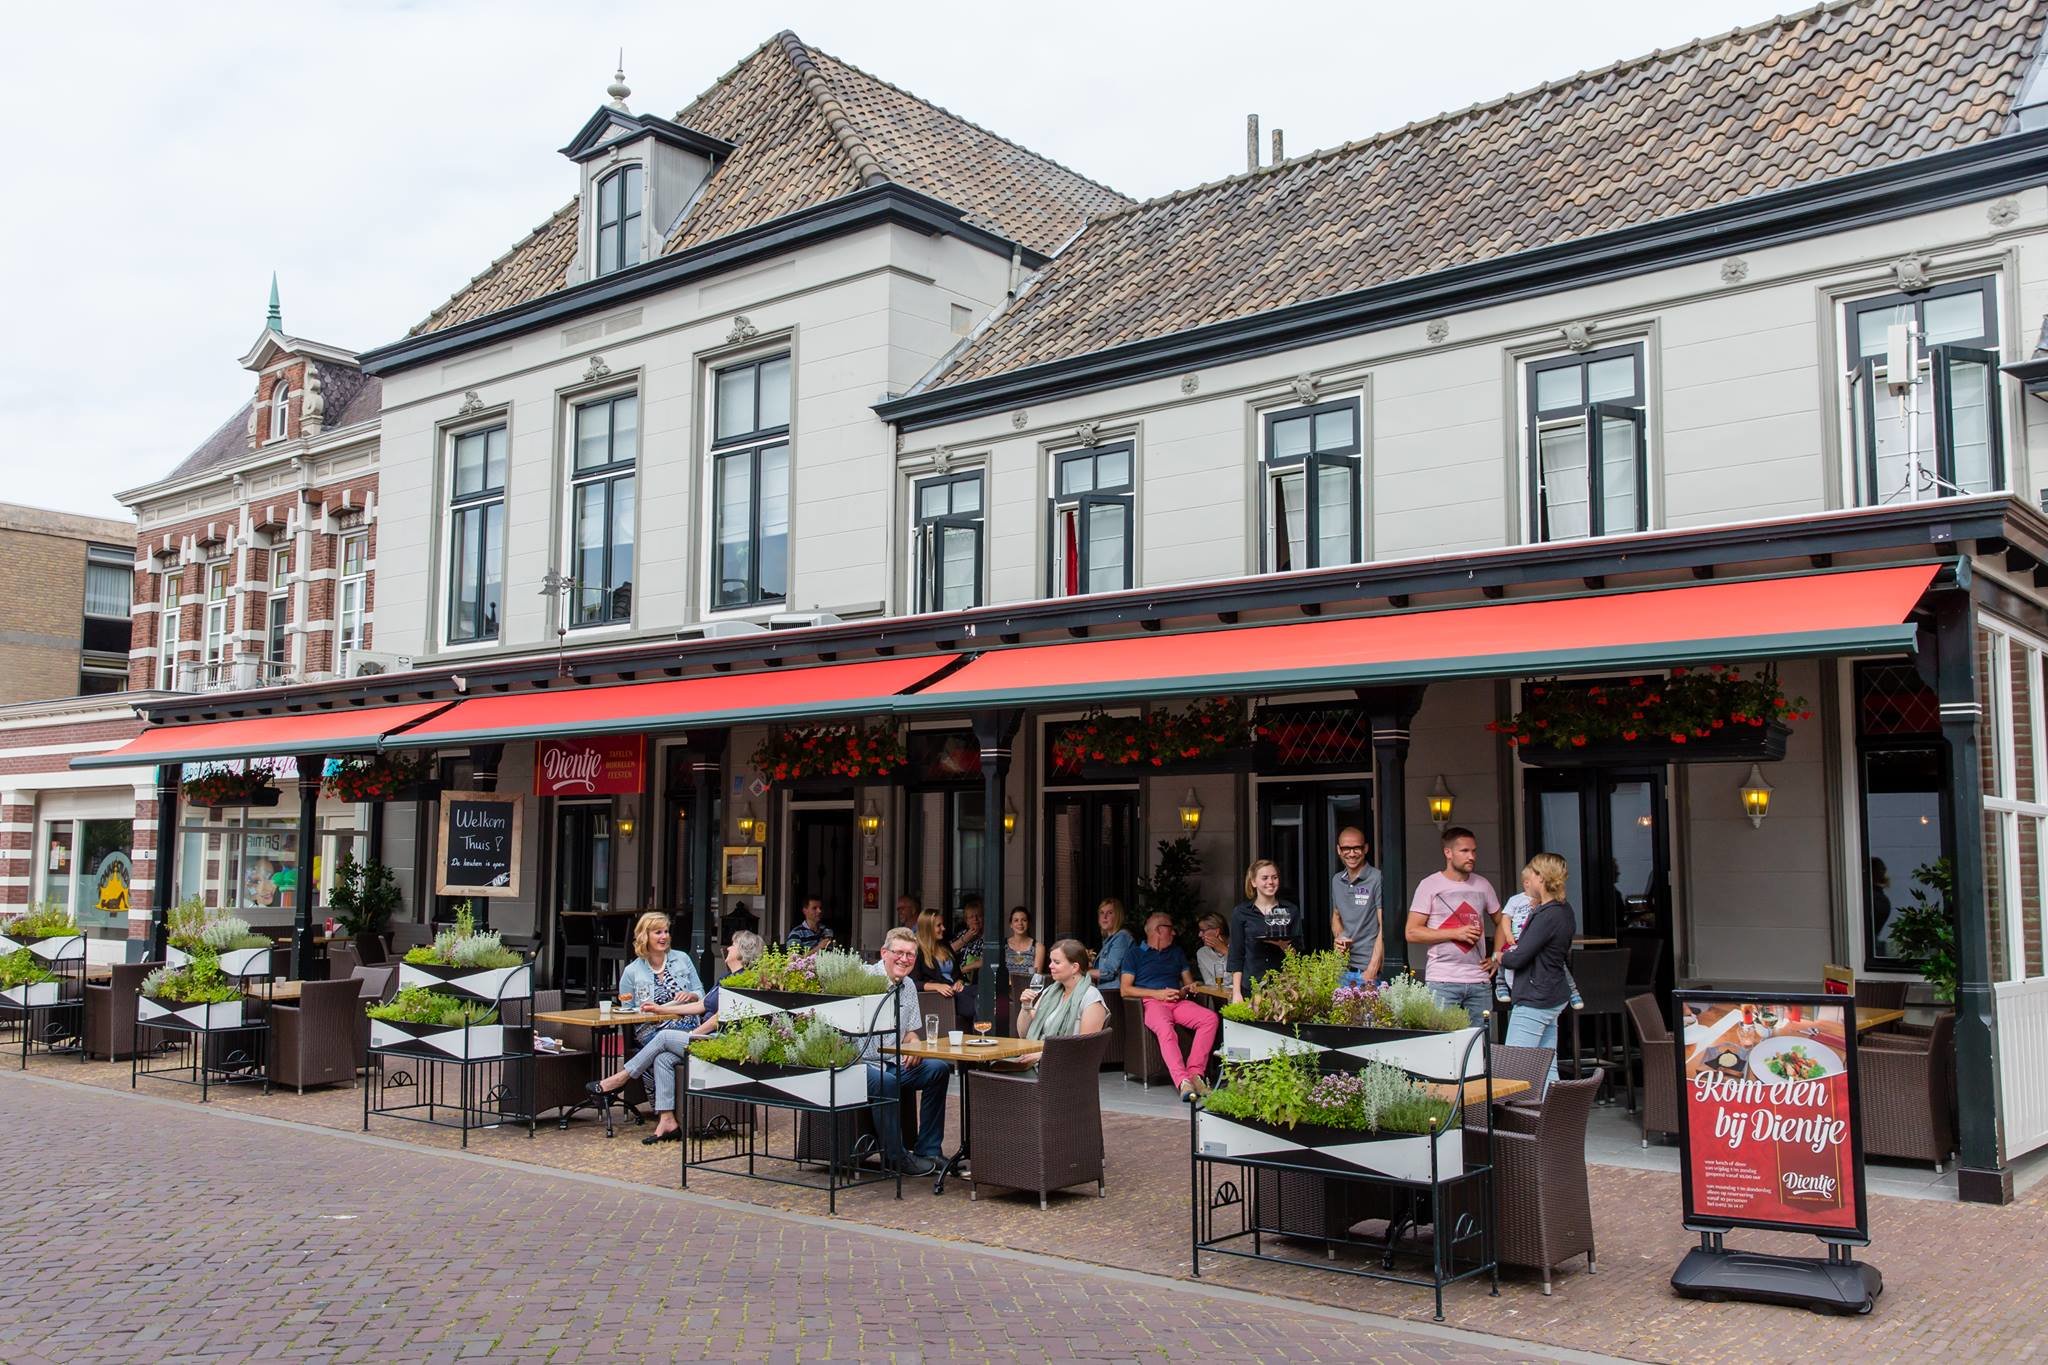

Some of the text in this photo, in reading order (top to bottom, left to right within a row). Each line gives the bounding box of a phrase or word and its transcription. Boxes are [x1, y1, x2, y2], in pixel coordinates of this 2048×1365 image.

[543, 747, 602, 793] Dientje
[456, 809, 506, 829] Welkom
[459, 834, 491, 851] Thuis
[492, 861, 506, 870] open
[1694, 1071, 1828, 1107] Kom eten
[1715, 1107, 1847, 1153] bij Dientje
[1782, 1172, 1837, 1199] Dientje
